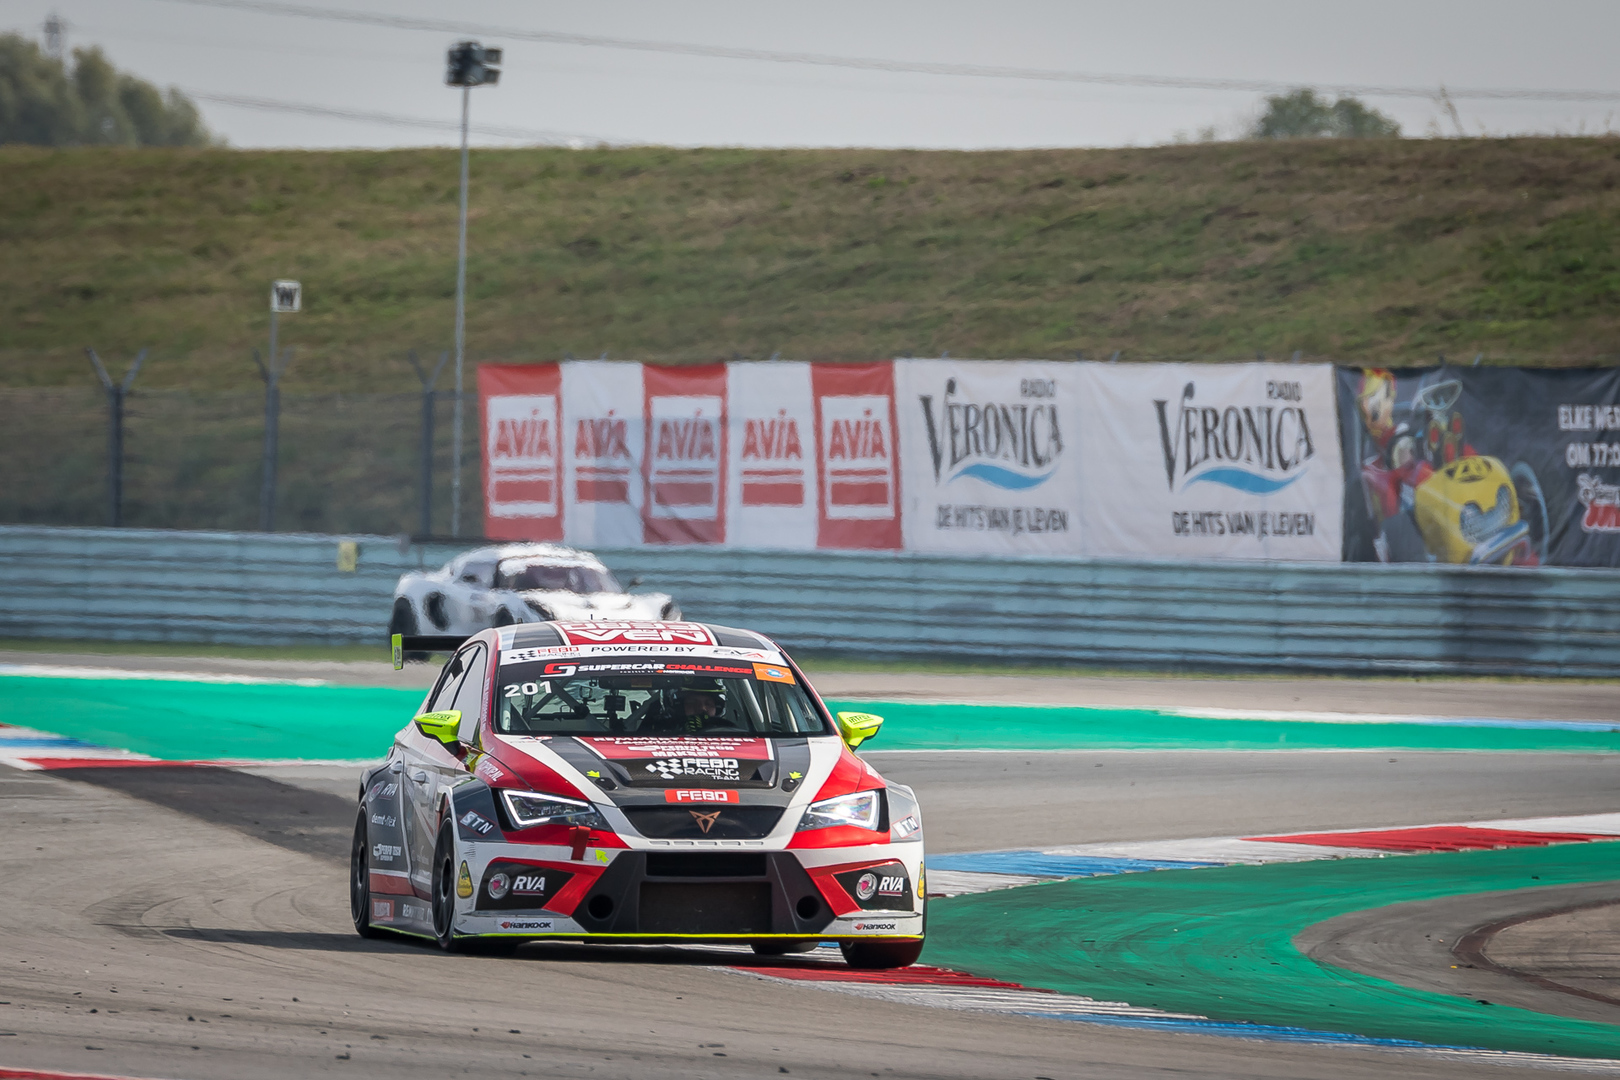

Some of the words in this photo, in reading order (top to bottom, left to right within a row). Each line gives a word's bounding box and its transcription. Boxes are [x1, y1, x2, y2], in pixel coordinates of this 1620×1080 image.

[494, 409, 552, 458] AVIA
[574, 409, 630, 458] AVIA
[656, 409, 715, 459] AVIA
[741, 409, 803, 460] AVIA
[829, 409, 887, 460] AVIA
[918, 377, 1065, 484] VERONICA
[1153, 380, 1315, 491] VERONICA
[591, 646, 669, 654] POWERED
[673, 646, 695, 654] BY
[577, 663, 665, 673] SUPERCAR
[665, 663, 753, 675] CHALLENGE
[503, 681, 553, 698] 201
[682, 758, 739, 769] FEBO
[683, 767, 740, 776] RACING
[676, 790, 729, 802] FEBO
[461, 810, 496, 835] STN
[512, 875, 546, 892] RVA
[878, 876, 904, 891] RVA
